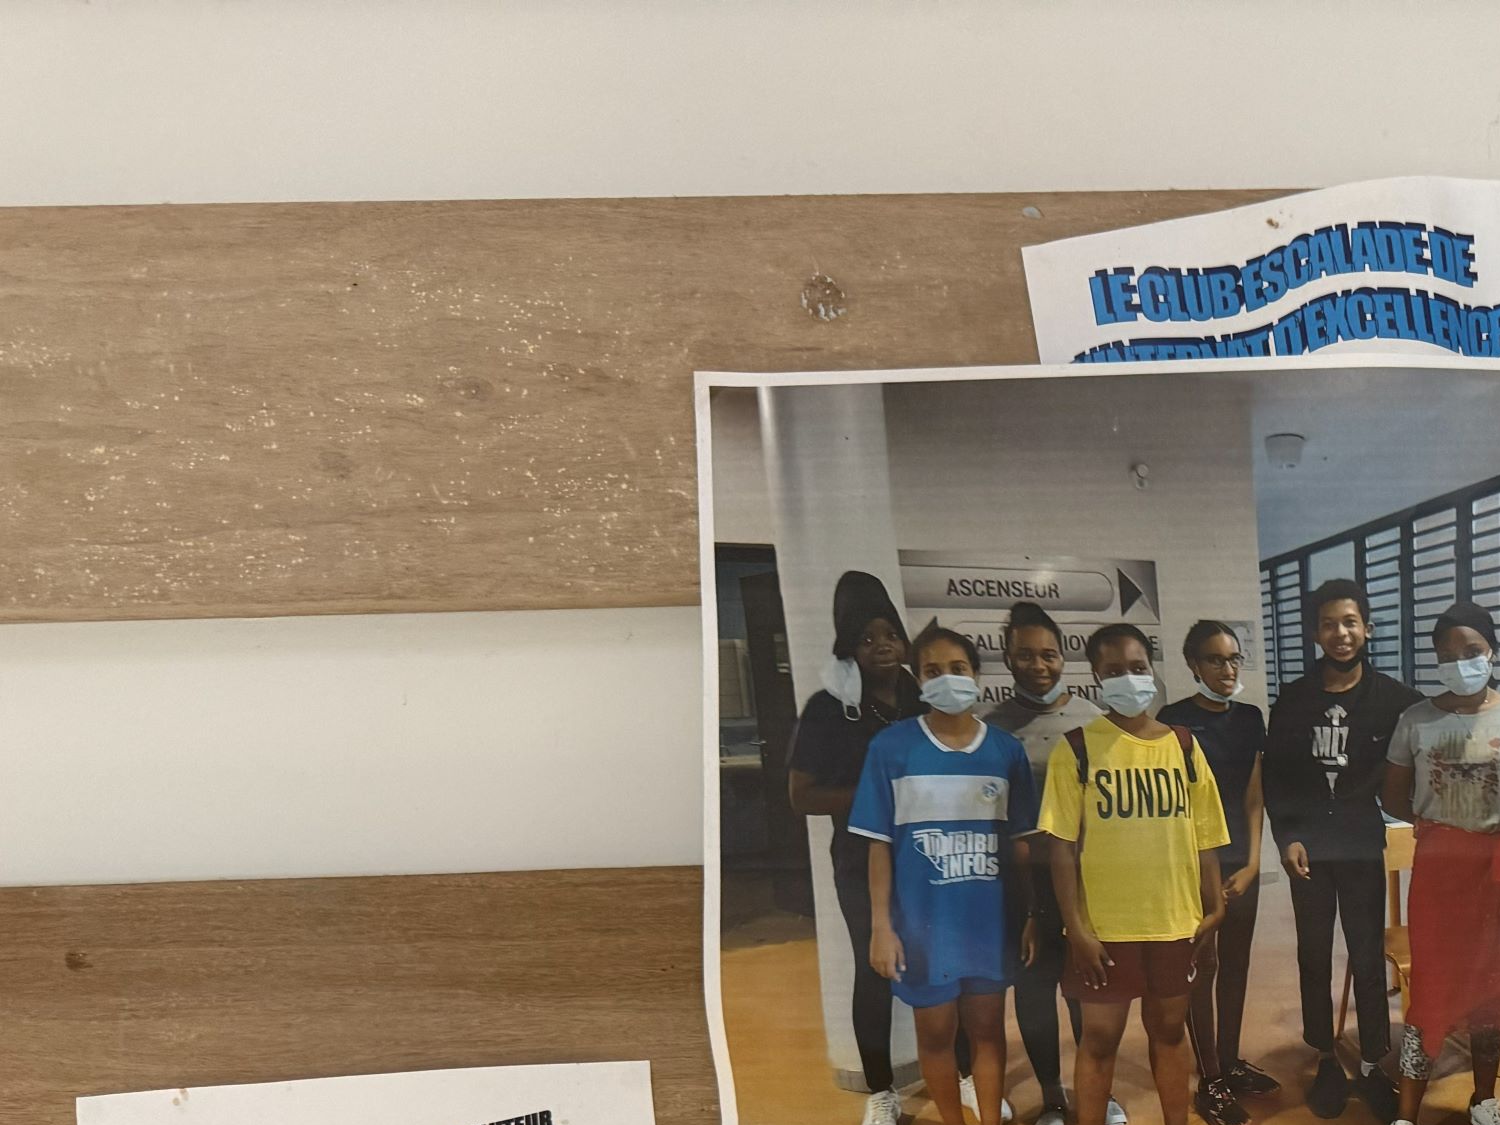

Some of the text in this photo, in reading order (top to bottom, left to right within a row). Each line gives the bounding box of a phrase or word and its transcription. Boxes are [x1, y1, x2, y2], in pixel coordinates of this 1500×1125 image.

[1089, 220, 1479, 326] LE CLUB ESCALADE DE
[946, 578, 1060, 599] ASCENSEUR
